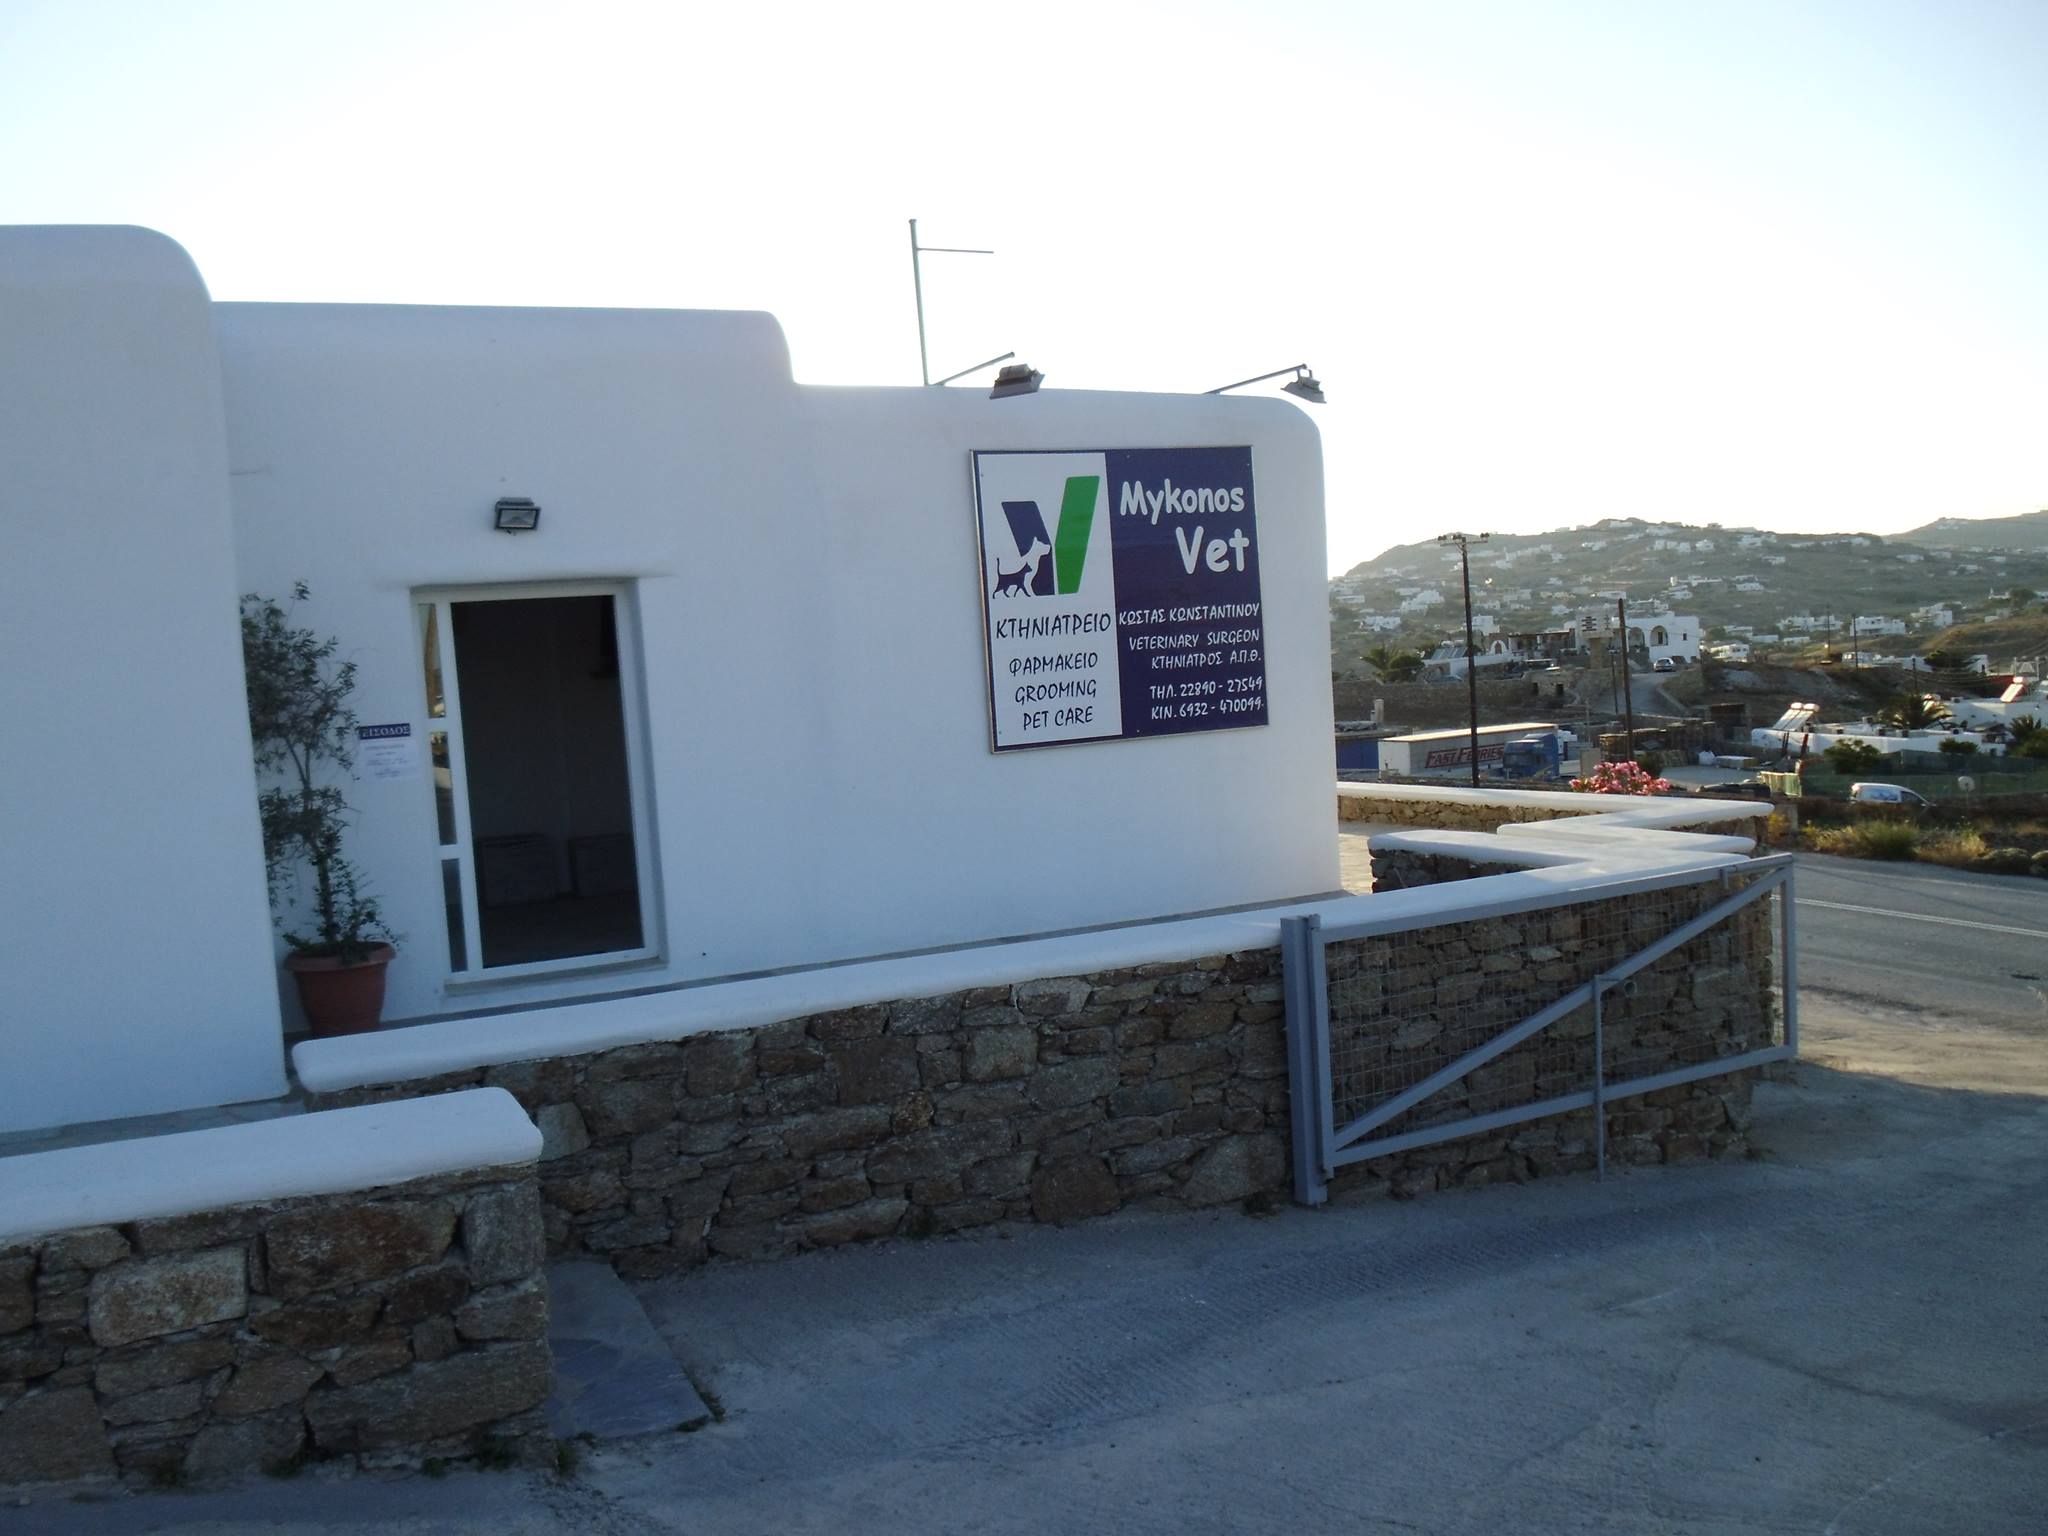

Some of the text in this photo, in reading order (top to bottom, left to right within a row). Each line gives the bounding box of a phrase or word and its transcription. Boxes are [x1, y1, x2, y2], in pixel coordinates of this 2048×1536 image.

[1120, 478, 1245, 526] Mykonos
[1175, 526, 1250, 575] Vet
[996, 612, 1112, 640] ΚΤΗΝΙΑΤΡΕΙΟ
[1119, 602, 1260, 625] ΚΩΣΤΑΣ ΚΩΝΣΤΑΝΤΙΝΟΥ
[1129, 628, 1260, 651] VETERINARY SURGEON
[1009, 652, 1098, 677] ΦΑΡΜΑΚΕΙΟ
[1151, 651, 1223, 669] ΚΤΗΝΙΑΤΡΟΣ
[1015, 679, 1097, 706] GROOMING
[1150, 684, 1177, 700] ΤΗΛ.
[1180, 681, 1216, 698] 22890
[1227, 676, 1263, 693] 27549
[1023, 706, 1093, 731] PET CARE
[1151, 705, 1177, 720] ΚΙΝ.
[1180, 702, 1208, 718] 6932
[1425, 743, 1505, 768] FAST FERIES
